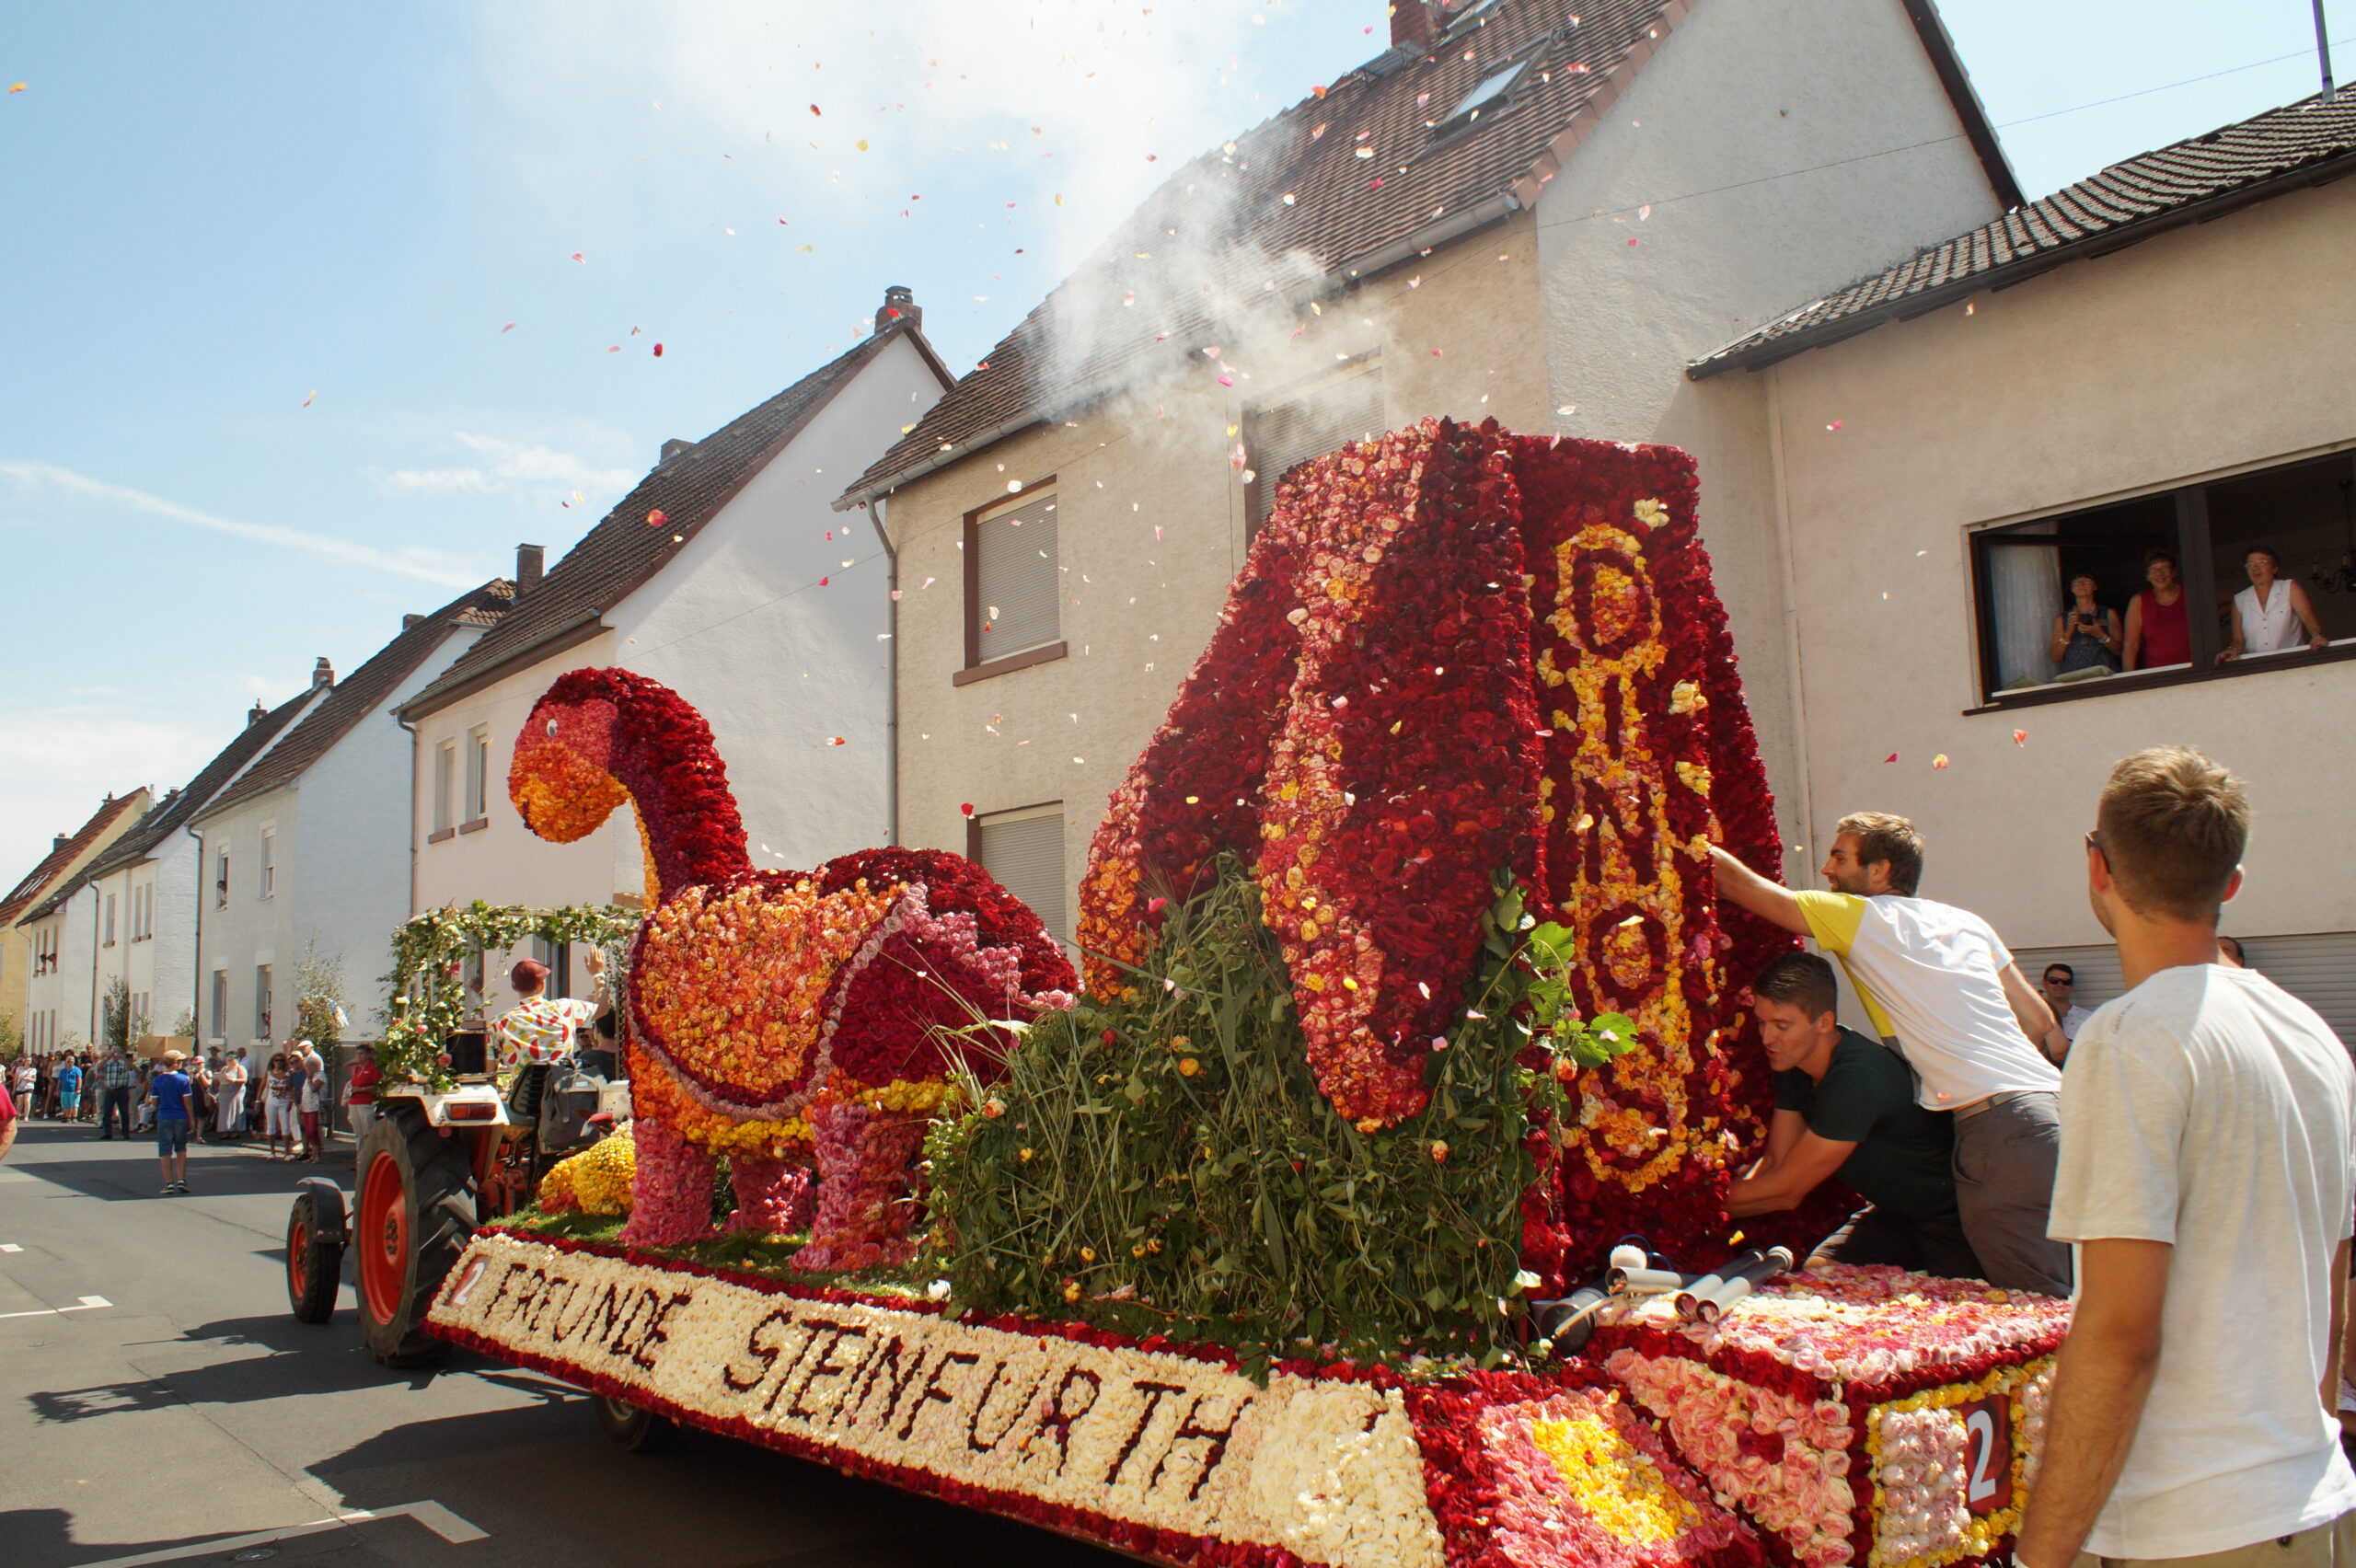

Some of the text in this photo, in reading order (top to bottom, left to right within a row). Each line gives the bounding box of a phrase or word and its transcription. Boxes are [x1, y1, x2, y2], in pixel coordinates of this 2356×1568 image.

[454, 1262, 486, 1305] 2
[484, 1262, 1253, 1500] FREUNDE STEINFURTH
[1967, 1410, 1996, 1503] 2
